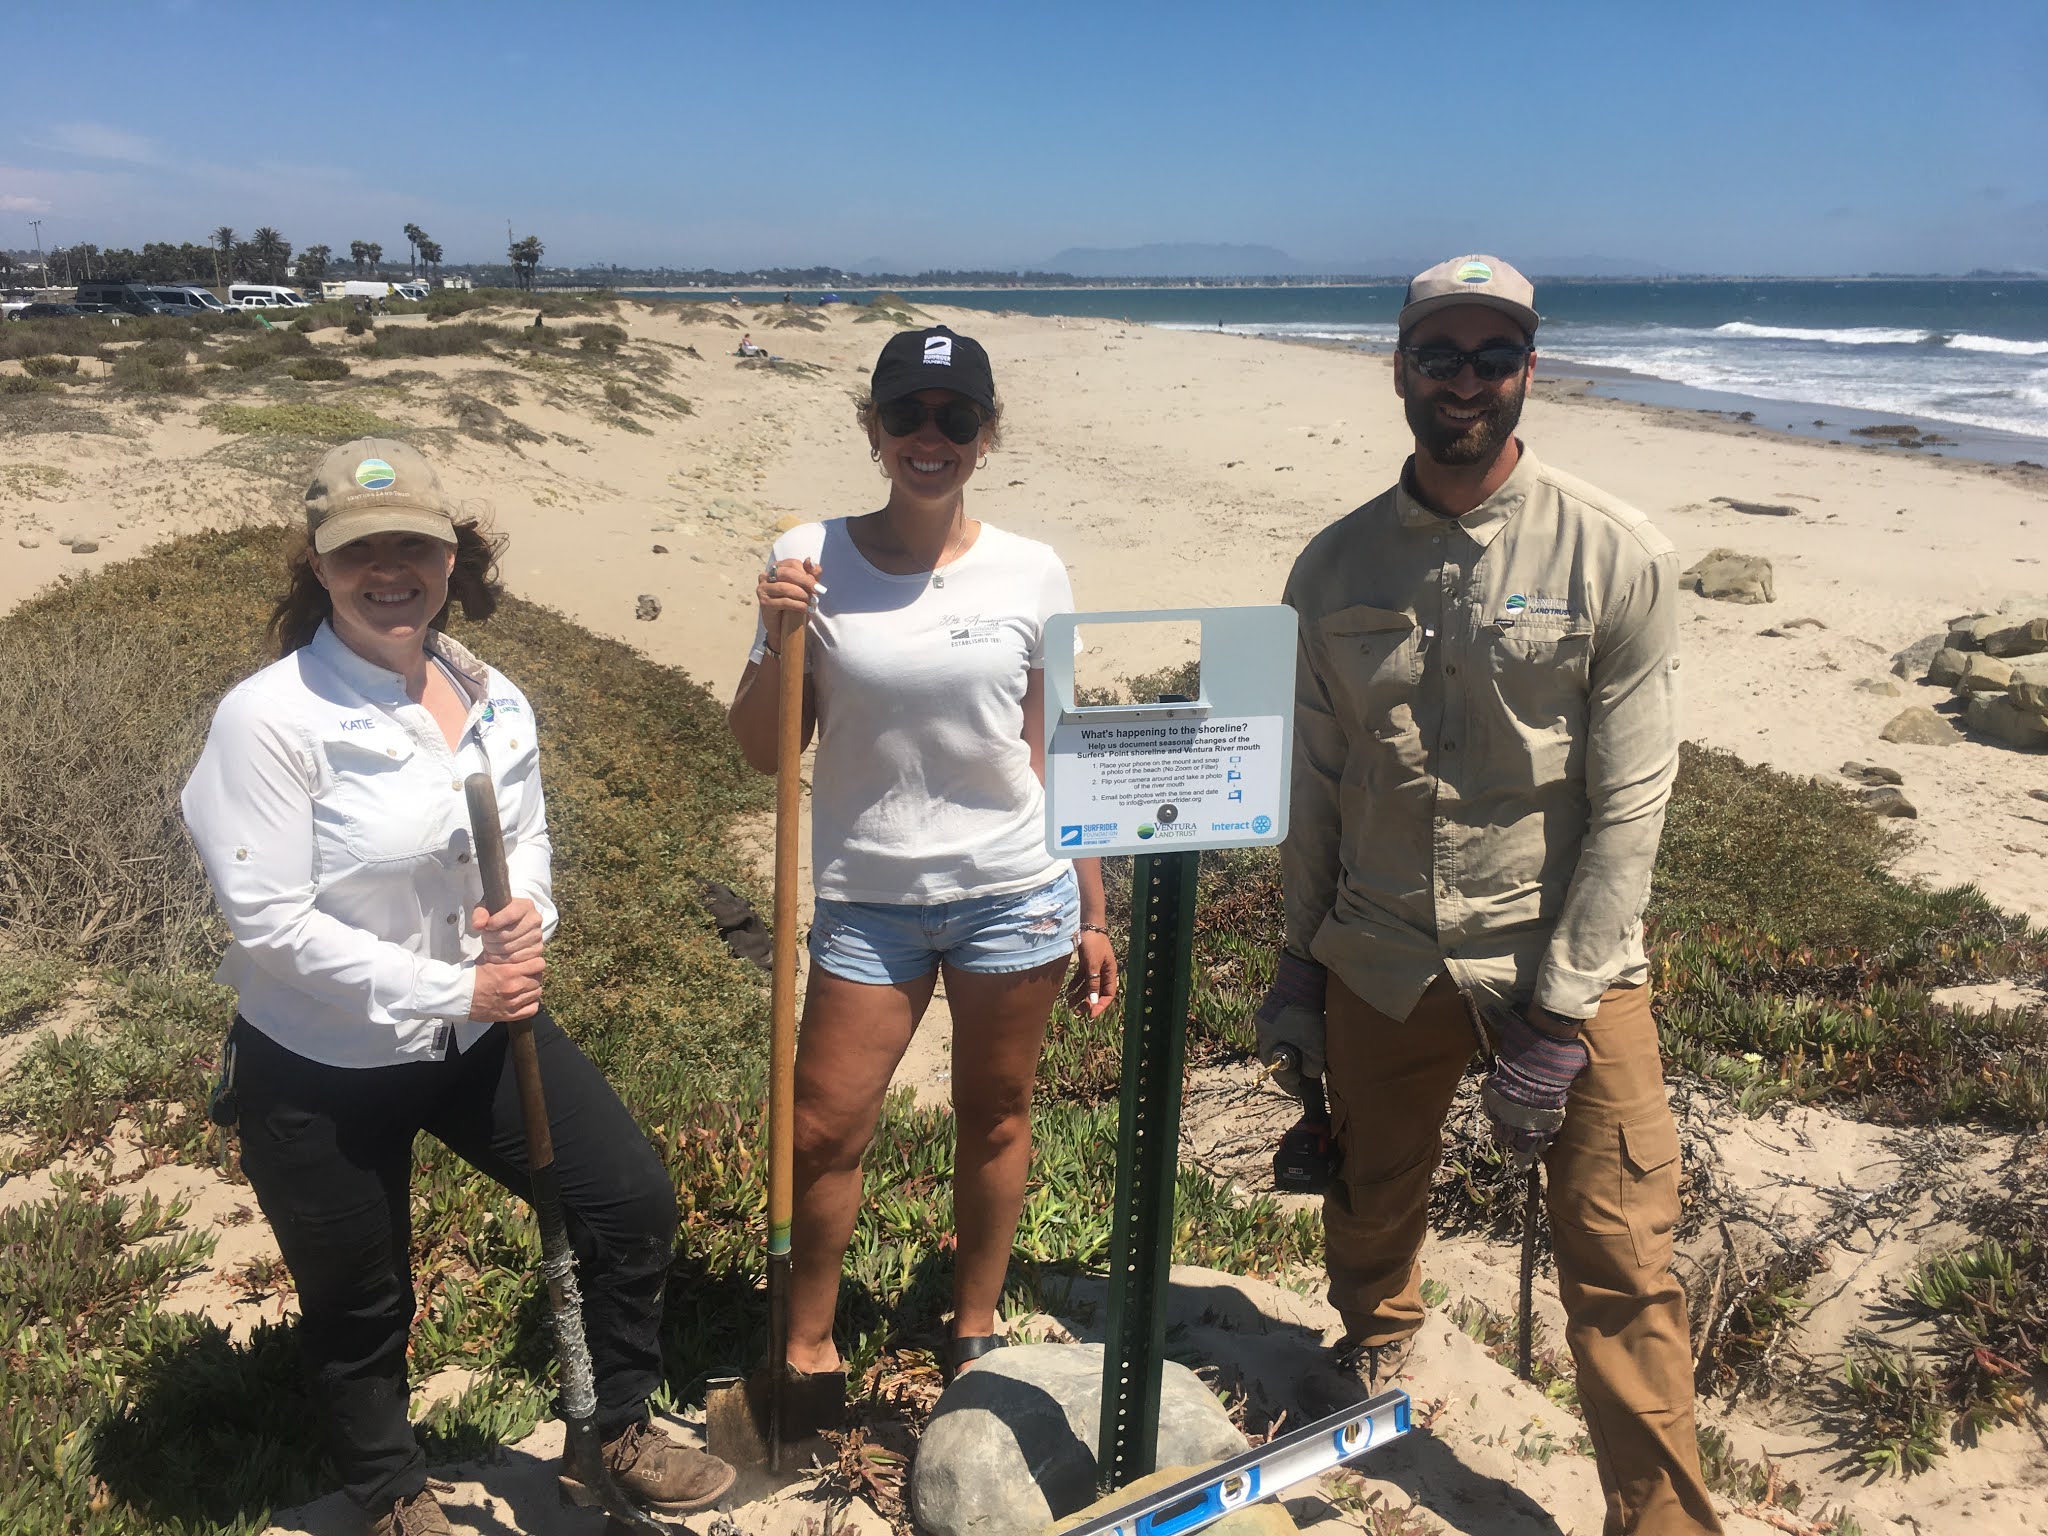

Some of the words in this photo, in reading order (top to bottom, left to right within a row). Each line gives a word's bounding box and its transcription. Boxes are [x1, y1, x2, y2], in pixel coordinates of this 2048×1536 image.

[1551, 608, 1572, 616] TRUST
[951, 637, 989, 648] ESTABLISHED
[340, 718, 375, 731] KATIE
[1081, 729, 1114, 739] What's
[1116, 727, 1166, 739] happening
[1169, 726, 1179, 735] to
[1181, 725, 1196, 735] the
[1198, 722, 1248, 734] shoreline?
[1088, 742, 1106, 750] Help
[1119, 740, 1157, 749] document
[1159, 738, 1193, 746] seasonal
[1109, 749, 1129, 757] Point
[1130, 748, 1166, 756] shoreline
[1184, 746, 1213, 754] Ventura
[1214, 744, 1235, 752] River
[1236, 743, 1261, 751] mouth
[1133, 792, 1154, 800] photos
[1083, 822, 1118, 832] SURFRIDER
[1154, 822, 1197, 832] VENTURA
[1211, 821, 1250, 832] Interact
[1083, 830, 1118, 838] FOUNDATION
[1154, 830, 1174, 839] LAND
[1175, 830, 1197, 838] TRUST
